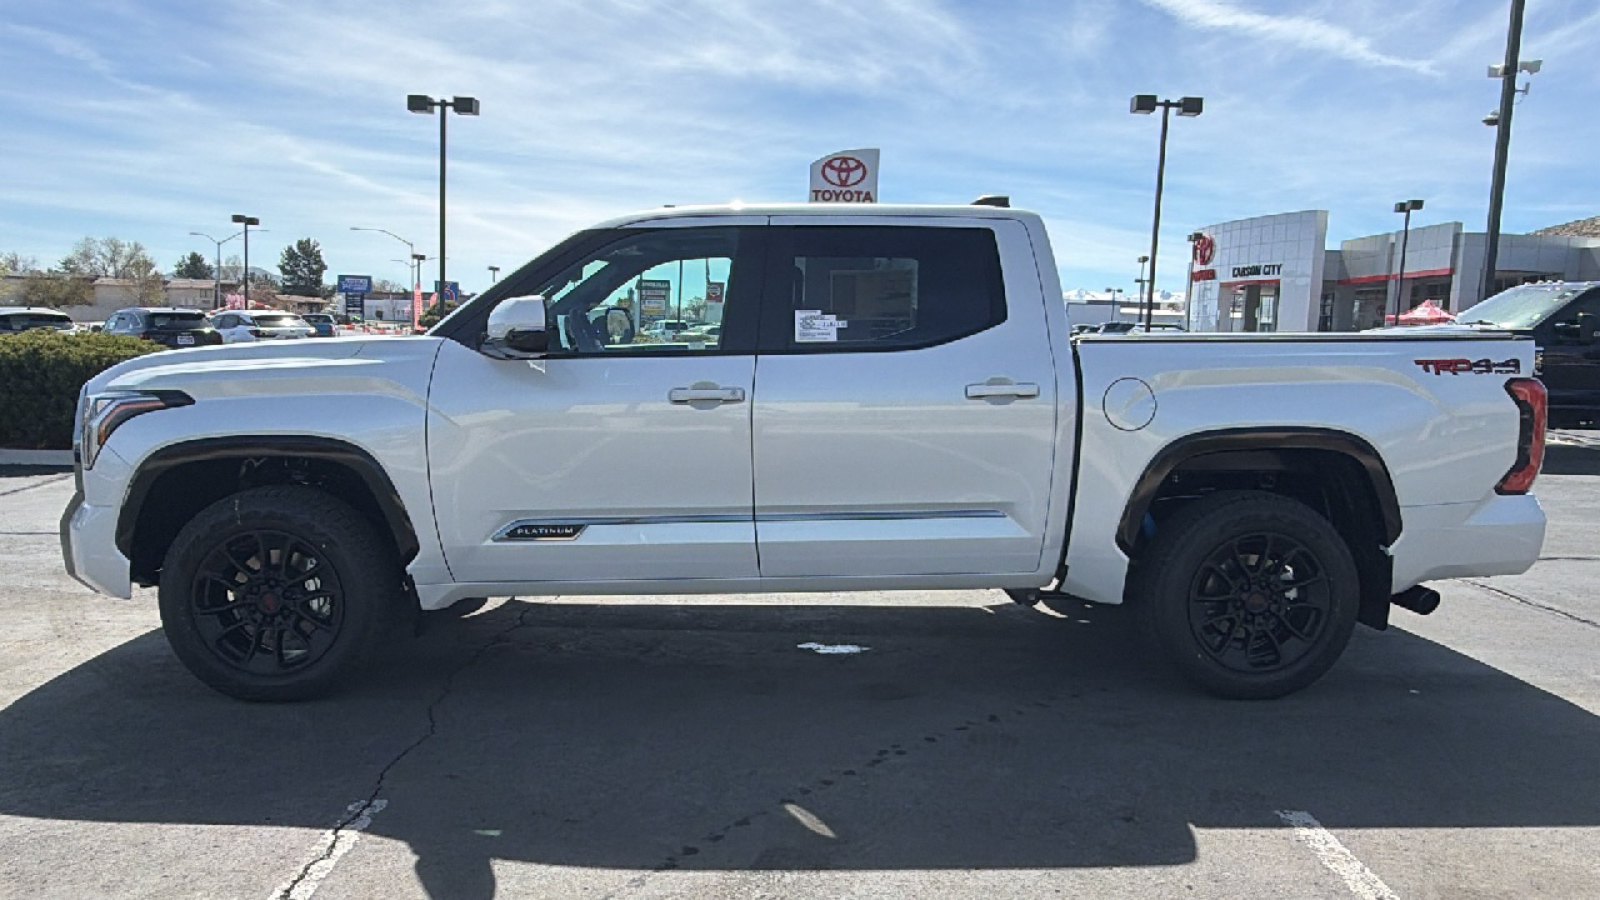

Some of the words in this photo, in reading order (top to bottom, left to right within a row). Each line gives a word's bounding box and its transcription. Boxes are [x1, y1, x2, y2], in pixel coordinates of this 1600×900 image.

[812, 189, 873, 202] TOYOTA
[1232, 265, 1261, 278] CARSON
[1263, 264, 1283, 275] CITY
[516, 527, 573, 535] PLATINUM
